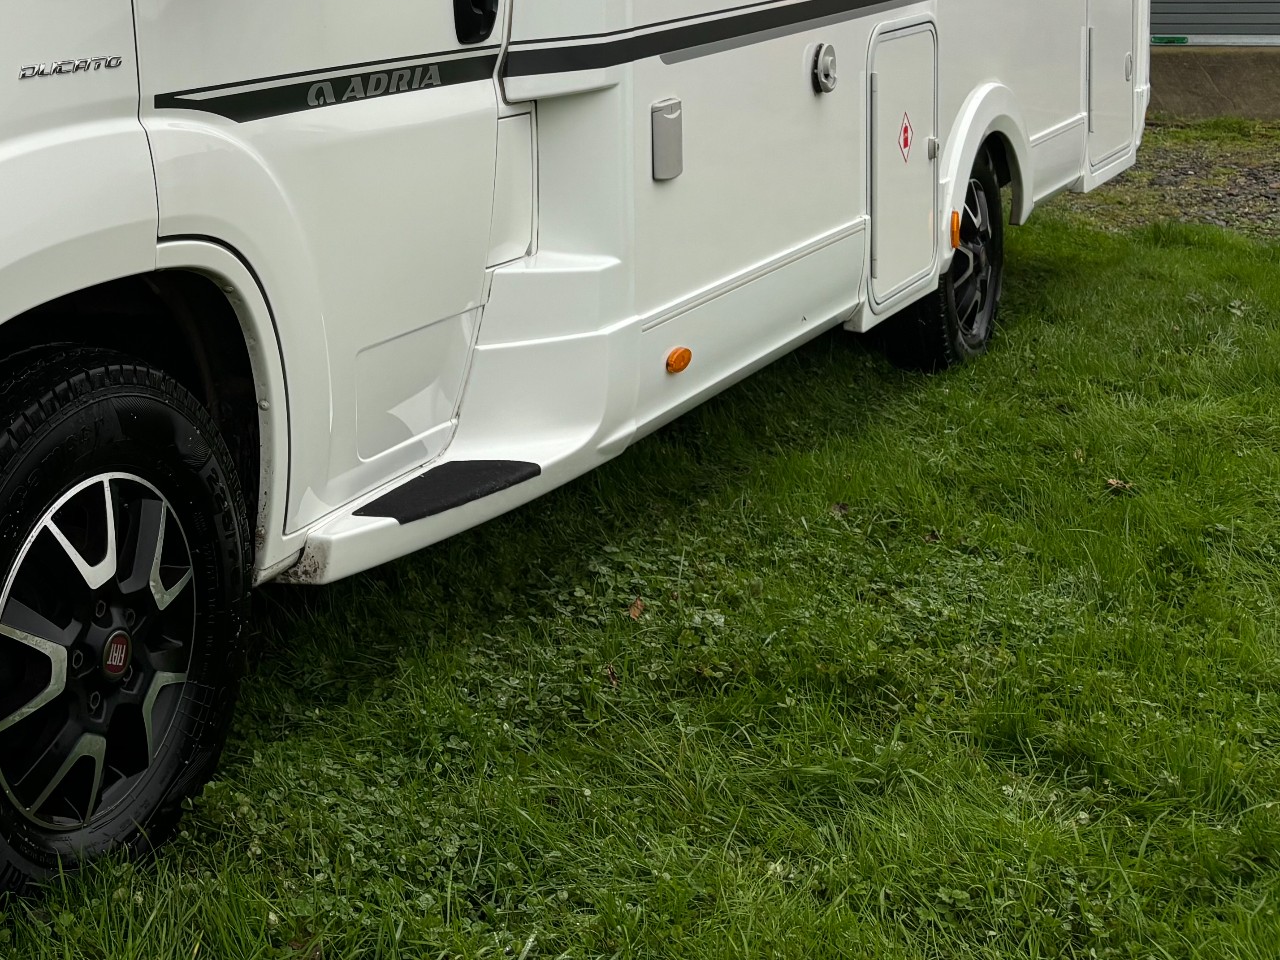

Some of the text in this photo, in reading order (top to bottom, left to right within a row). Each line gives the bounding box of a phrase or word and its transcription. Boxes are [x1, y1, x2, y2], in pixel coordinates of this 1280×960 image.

[18, 55, 122, 80] DUCATO
[341, 65, 442, 101] ADRIA
[106, 643, 127, 666] FIAT
